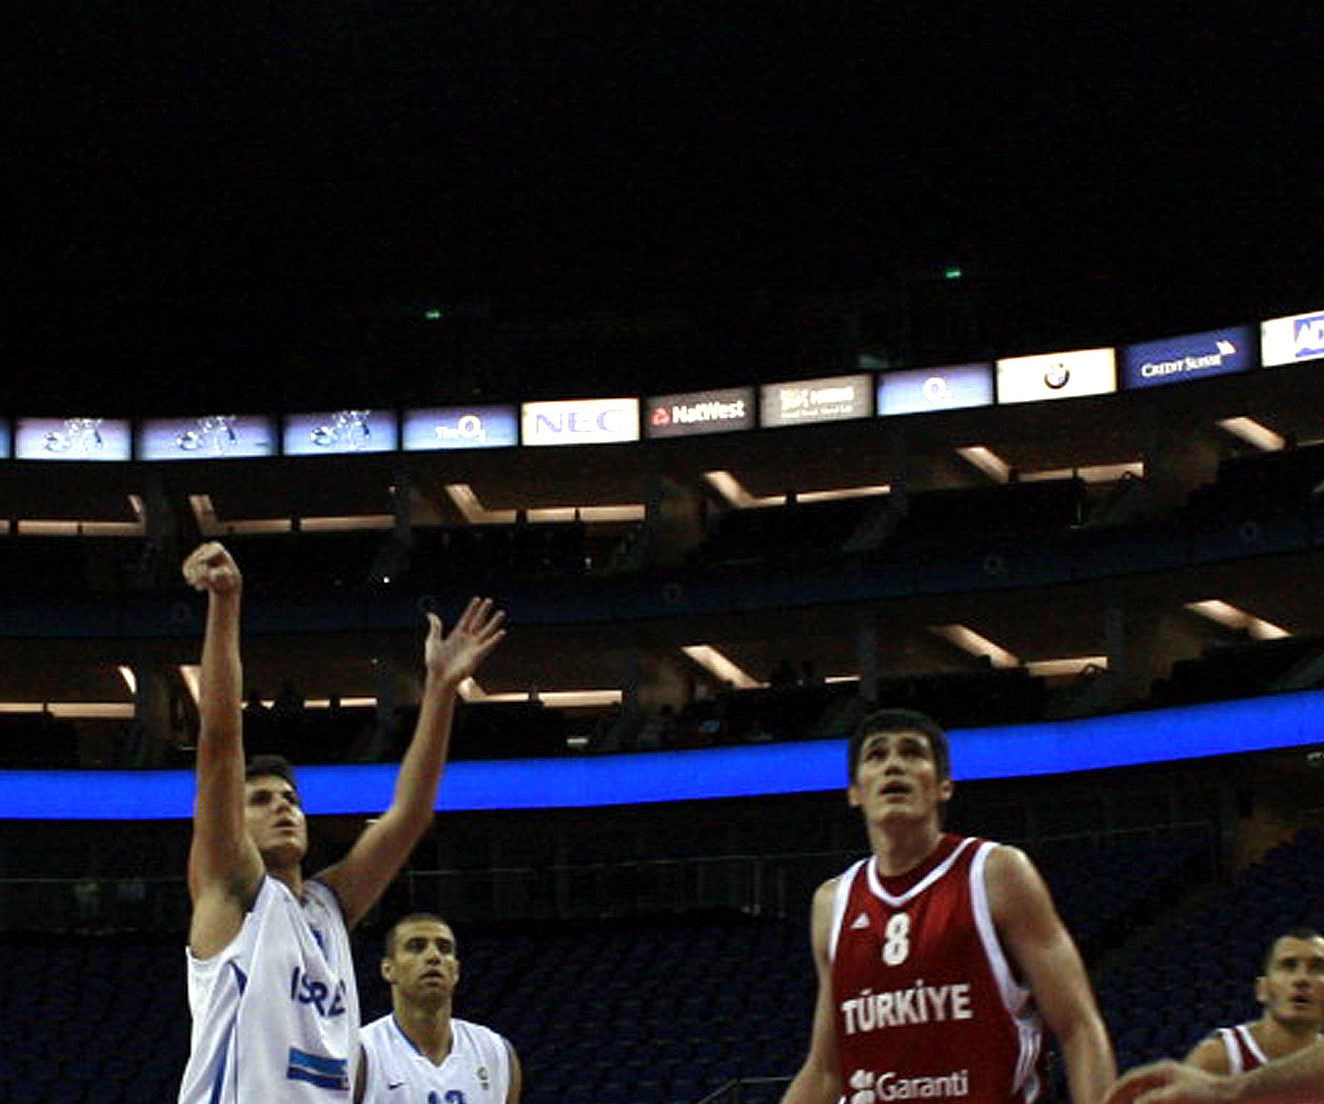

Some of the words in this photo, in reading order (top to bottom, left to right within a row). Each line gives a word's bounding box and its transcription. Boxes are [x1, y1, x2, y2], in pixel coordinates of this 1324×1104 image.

[536, 410, 624, 435] NEC
[672, 400, 745, 424] NatWest
[882, 912, 911, 967] 8
[841, 979, 974, 1036] TÜRKİYE
[876, 1070, 969, 1101] Garanti
